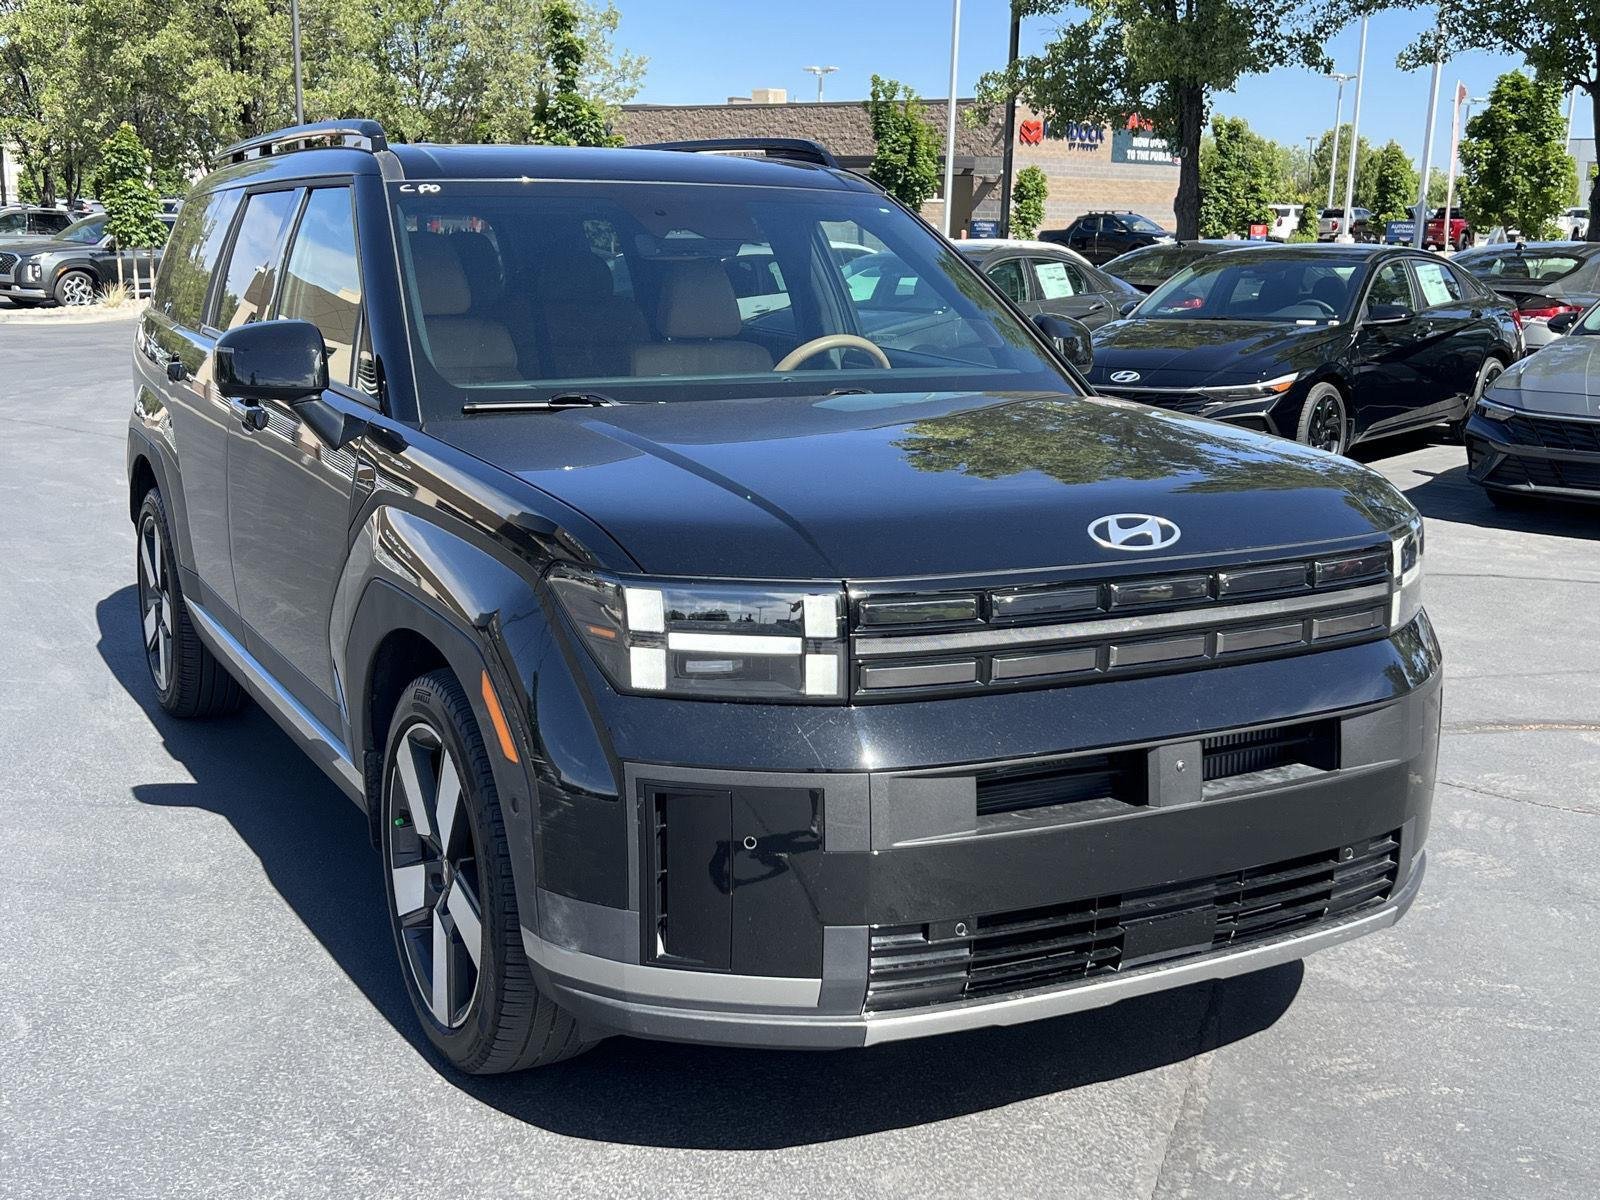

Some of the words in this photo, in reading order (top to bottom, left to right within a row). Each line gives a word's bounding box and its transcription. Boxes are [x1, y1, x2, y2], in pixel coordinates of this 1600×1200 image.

[1132, 137, 1149, 147] NOW
[1126, 149, 1136, 160] TO
[1137, 150, 1149, 160] THE
